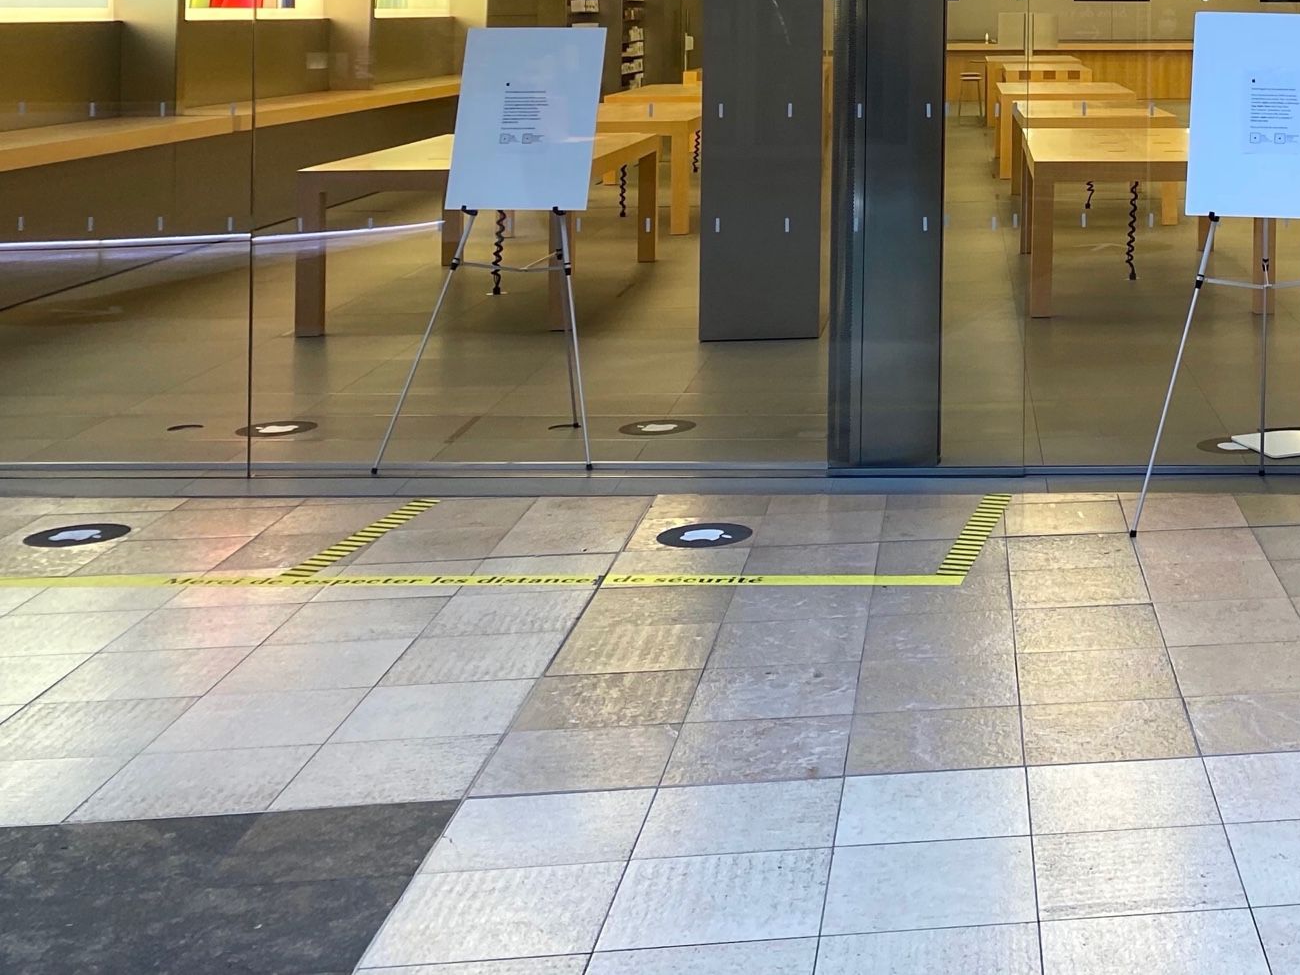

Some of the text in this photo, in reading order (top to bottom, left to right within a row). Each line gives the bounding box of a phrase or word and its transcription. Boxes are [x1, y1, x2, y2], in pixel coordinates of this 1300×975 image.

[291, 578, 423, 586] respecter
[430, 576, 469, 585] les
[612, 575, 645, 583] de
[653, 576, 764, 584] sécurité
